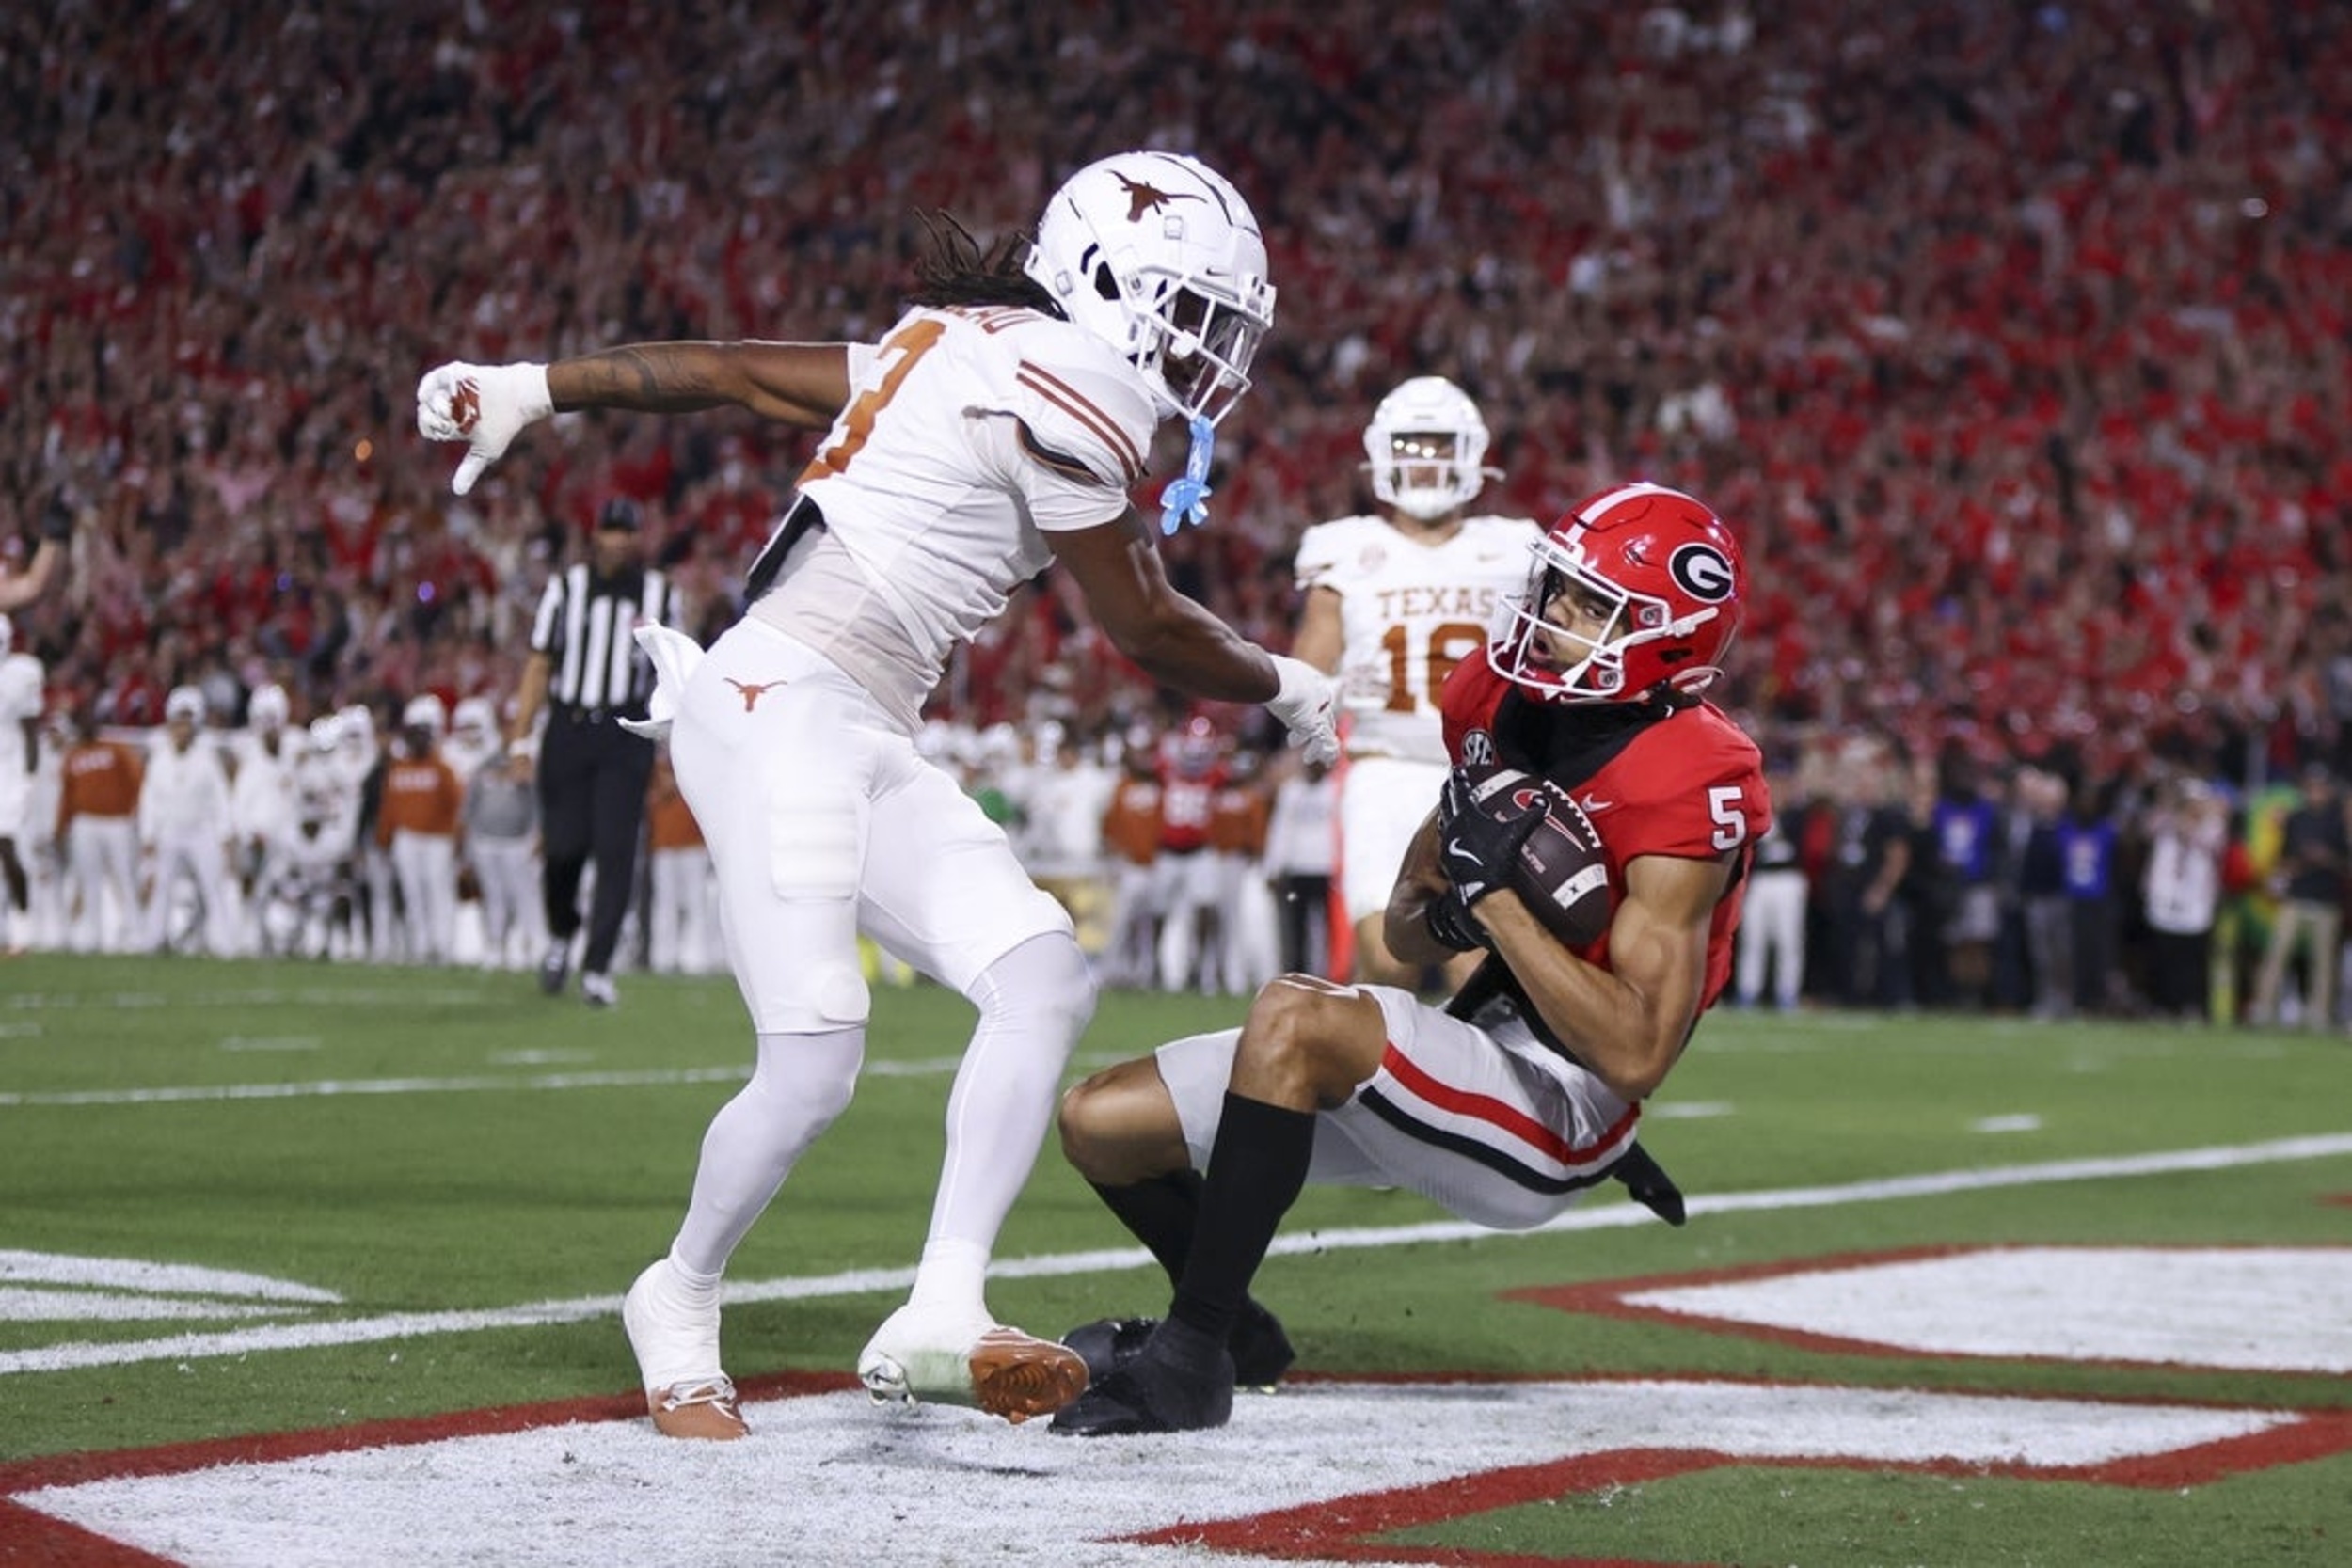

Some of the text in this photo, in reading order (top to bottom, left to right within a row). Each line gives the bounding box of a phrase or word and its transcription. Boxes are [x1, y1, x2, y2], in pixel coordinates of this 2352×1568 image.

[1376, 587, 1495, 619] TEXAS
[1669, 543, 1733, 603] G
[1707, 784, 1747, 851] 5
